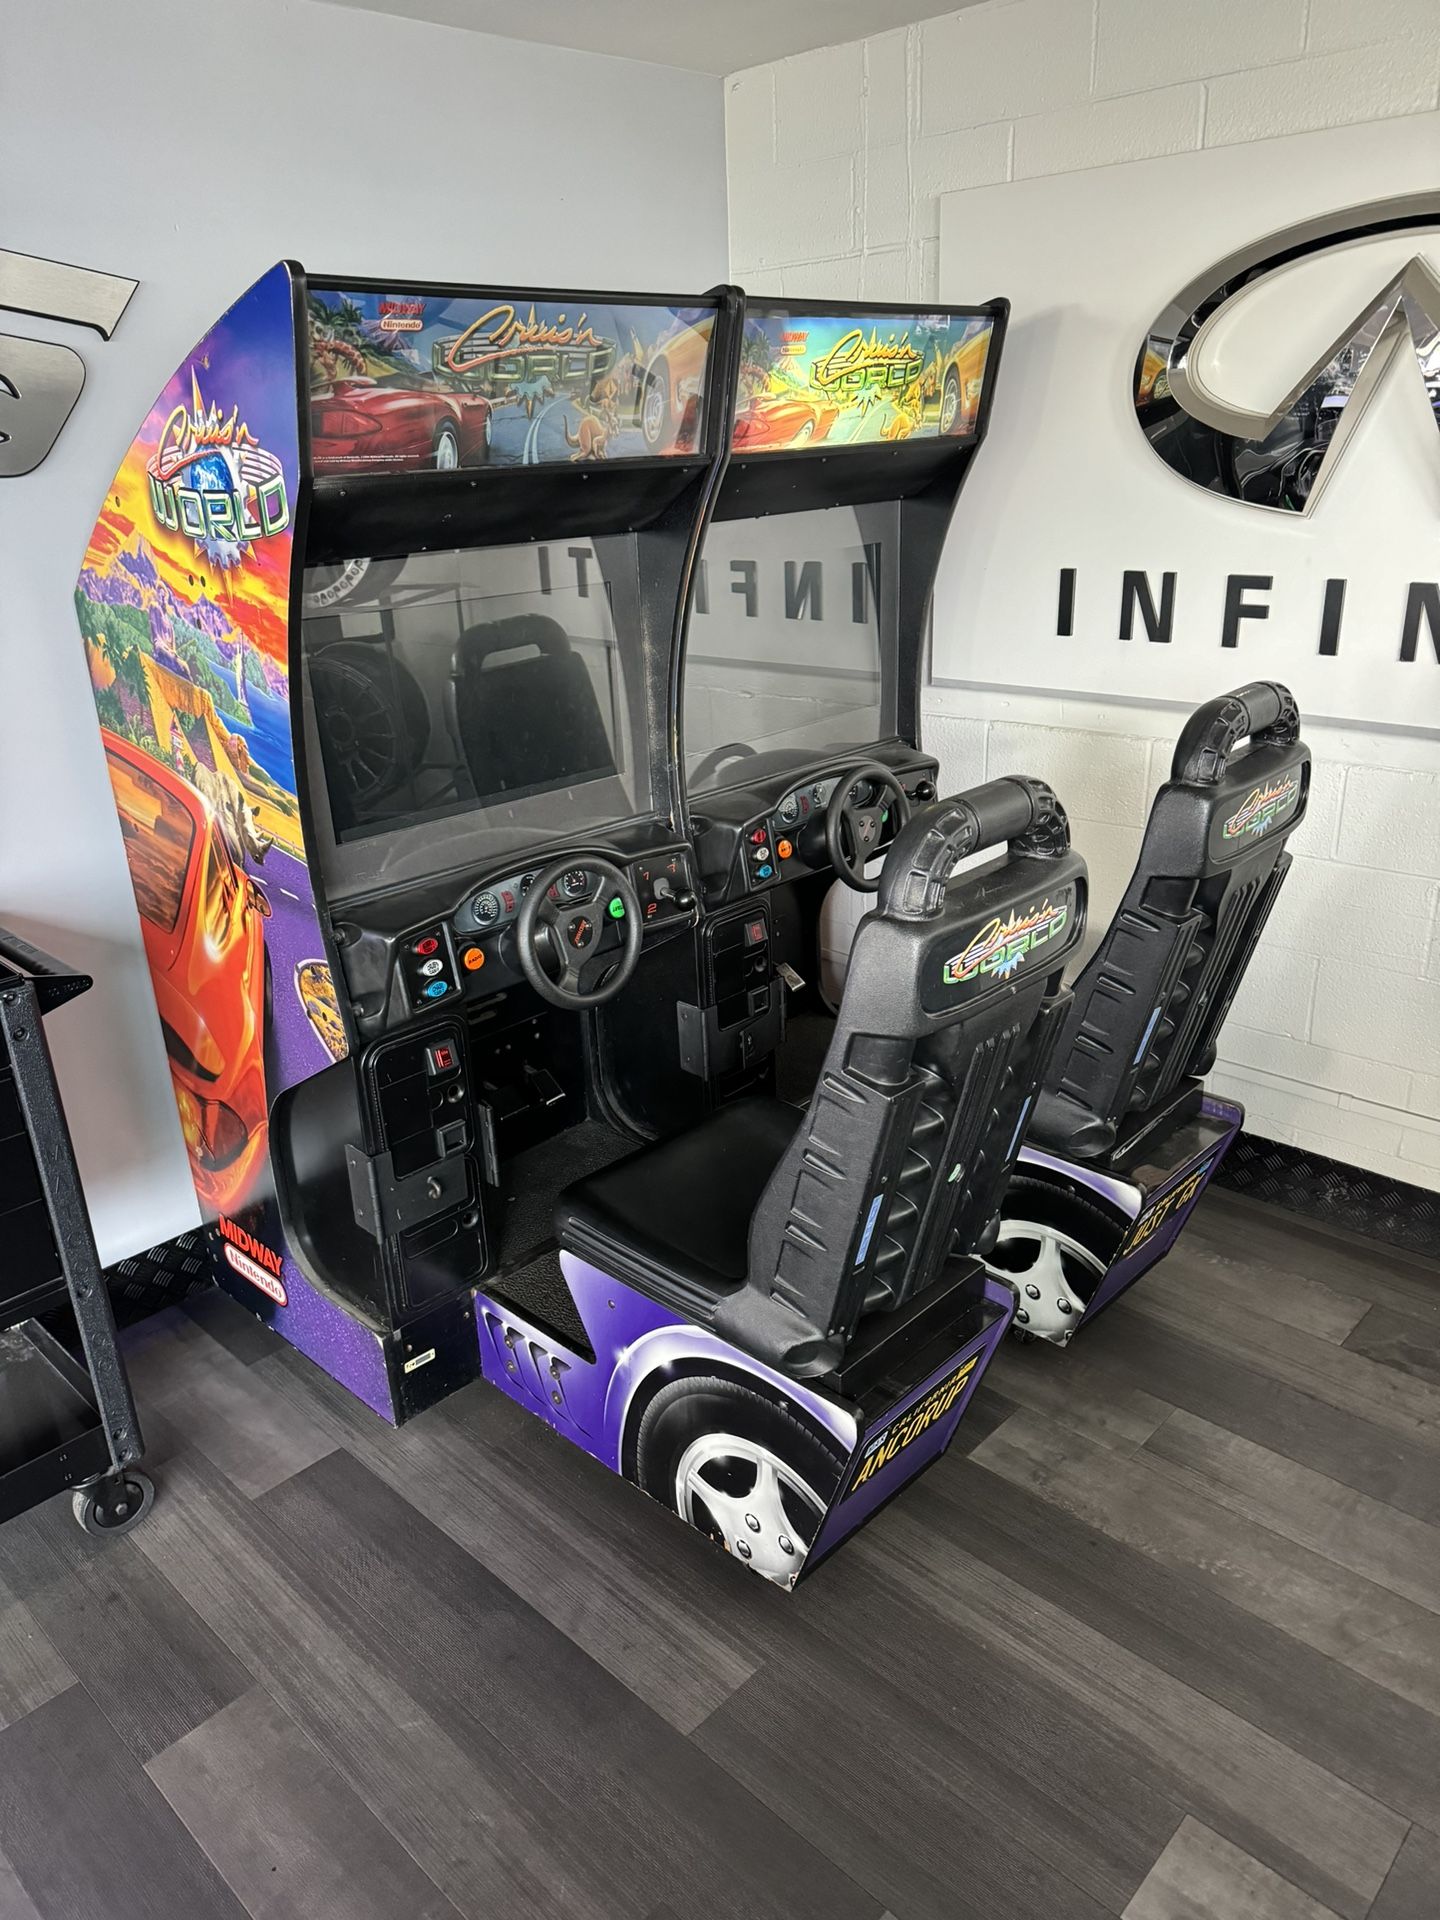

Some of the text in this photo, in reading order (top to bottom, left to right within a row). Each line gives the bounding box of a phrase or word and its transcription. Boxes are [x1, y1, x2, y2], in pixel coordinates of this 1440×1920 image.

[382, 320, 421, 329] Nintendo
[448, 304, 603, 373] Cruis'n
[817, 328, 917, 386] Cruis'n
[157, 402, 260, 482] Cruis'n
[147, 472, 290, 542] WORLD
[952, 898, 1058, 979] Cruis'n
[218, 1213, 283, 1277] MIDWAY
[229, 1248, 283, 1299] Nintendo
[851, 1375, 969, 1492] ANCORUP
